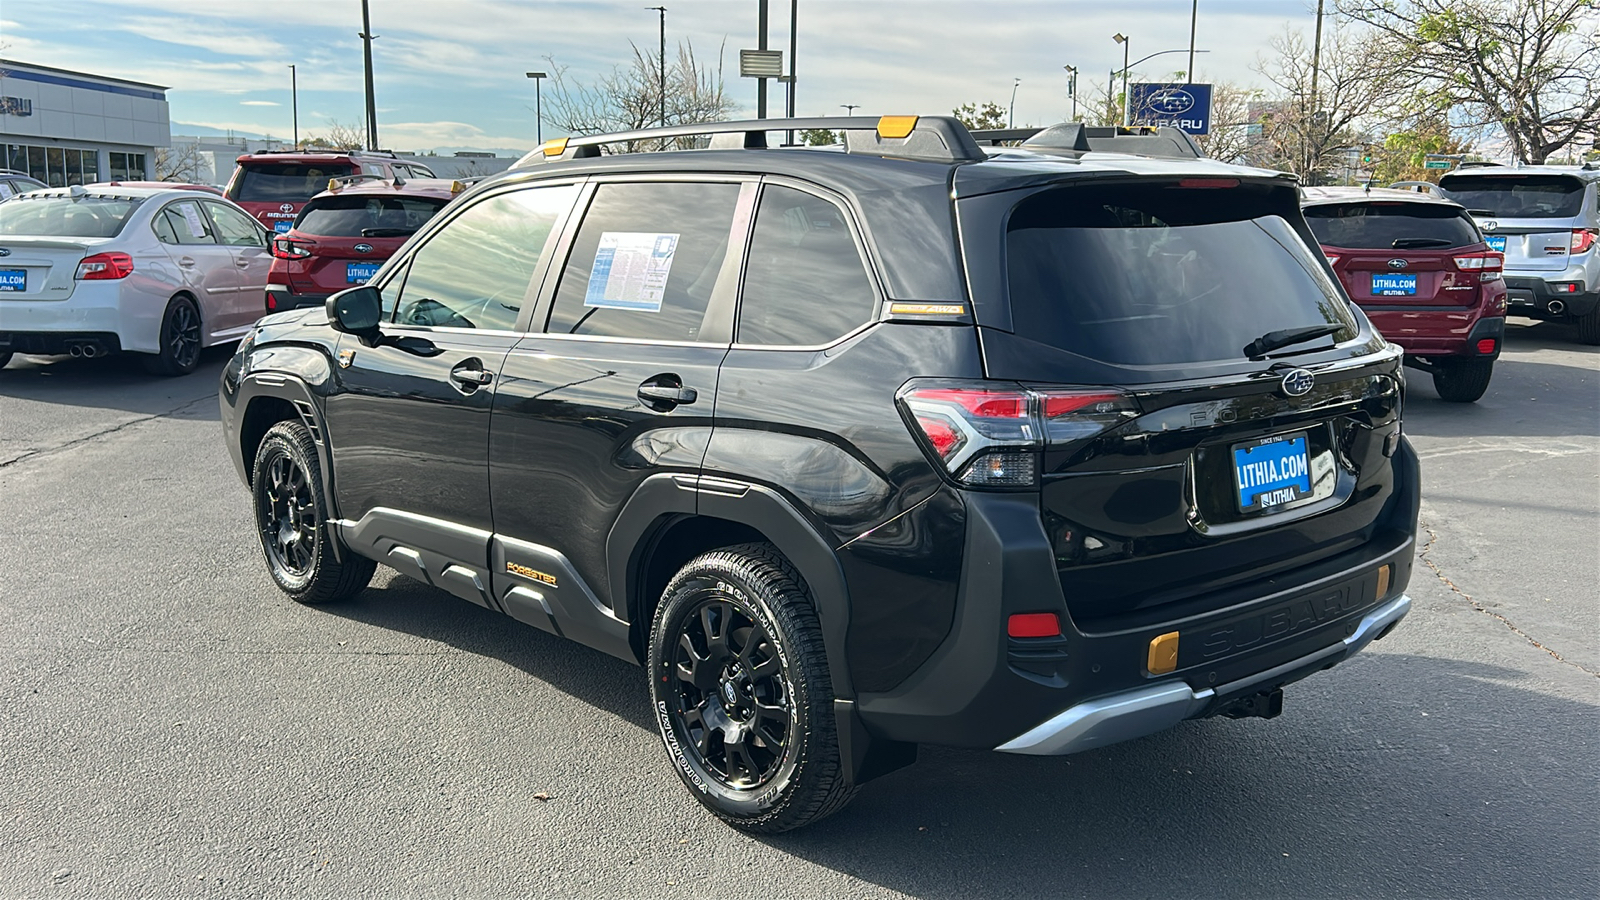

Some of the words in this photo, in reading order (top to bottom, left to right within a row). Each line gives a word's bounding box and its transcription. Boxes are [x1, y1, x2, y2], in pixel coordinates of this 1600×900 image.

[1373, 279, 1416, 289] LITHIA.COM
[1237, 453, 1308, 489] LITHIA.COM
[1268, 487, 1296, 506] LITHIA
[506, 561, 558, 585] FORESTER
[716, 581, 789, 668] GEOLANDAR
[1203, 580, 1366, 658] SUBARU
[658, 701, 709, 794] YOKOHAMA
